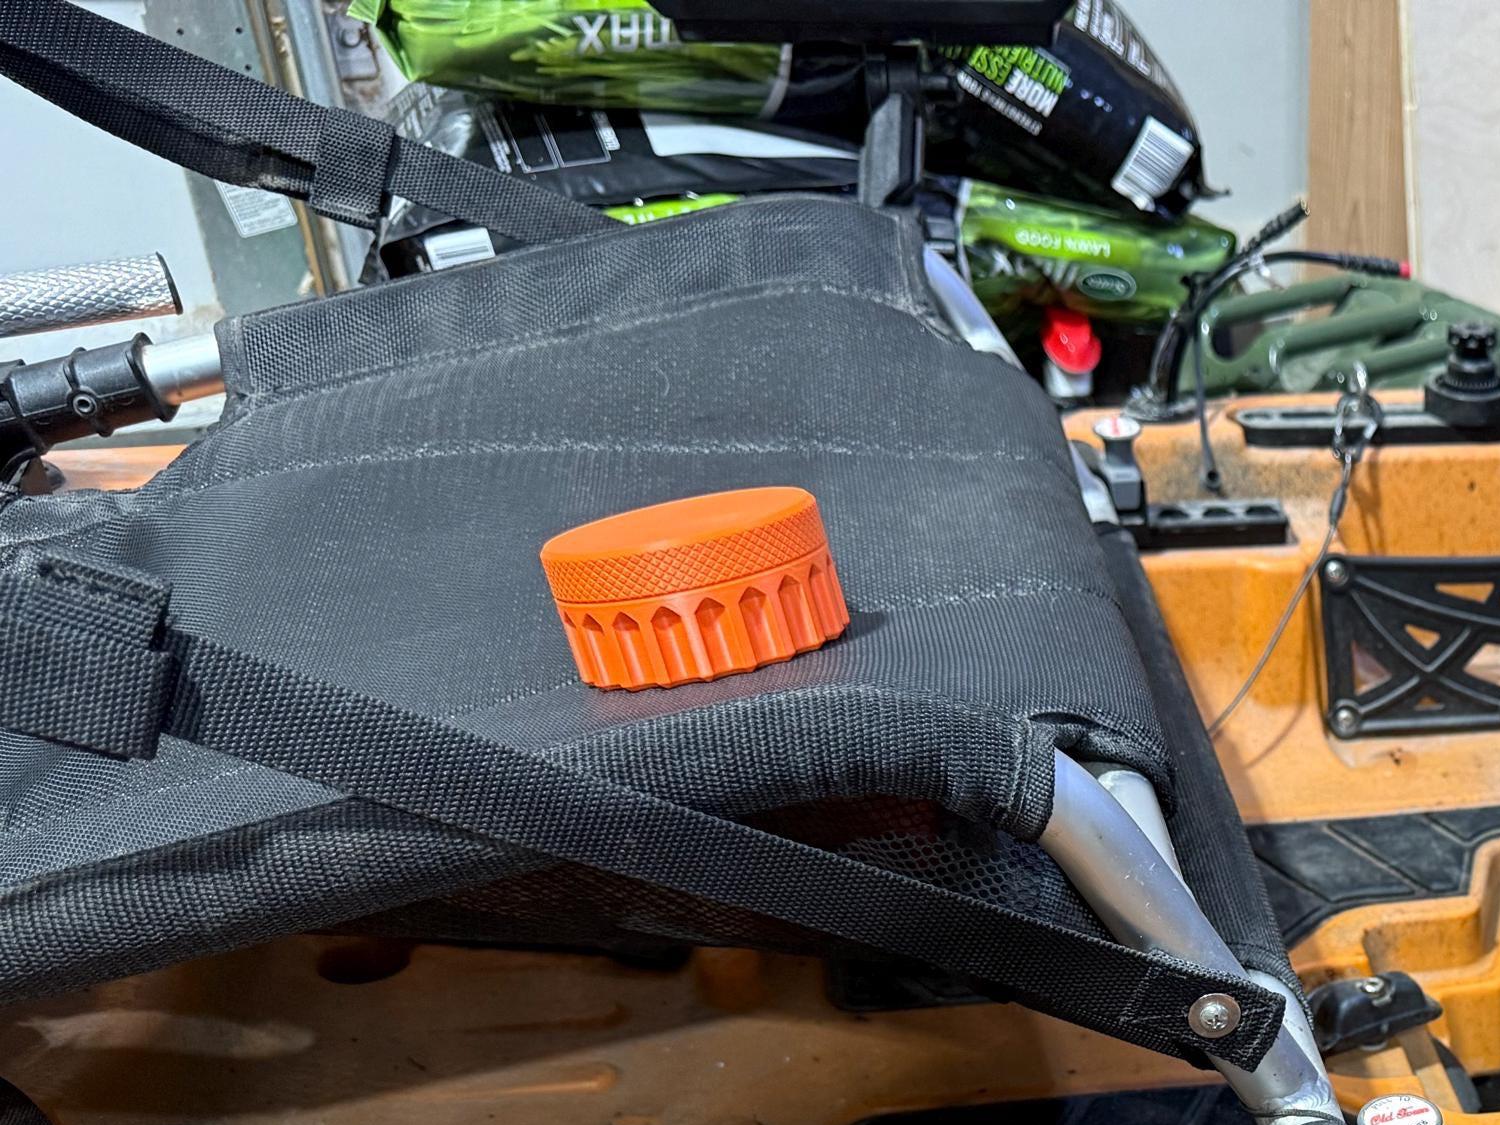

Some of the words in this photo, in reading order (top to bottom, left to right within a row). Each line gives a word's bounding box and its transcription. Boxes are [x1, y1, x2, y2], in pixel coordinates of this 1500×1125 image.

[1004, 67, 1059, 118] MORE
[1014, 229, 1061, 251] FOOD
[1065, 236, 1111, 258] LAWN
[1396, 1106, 1430, 1120] Town
